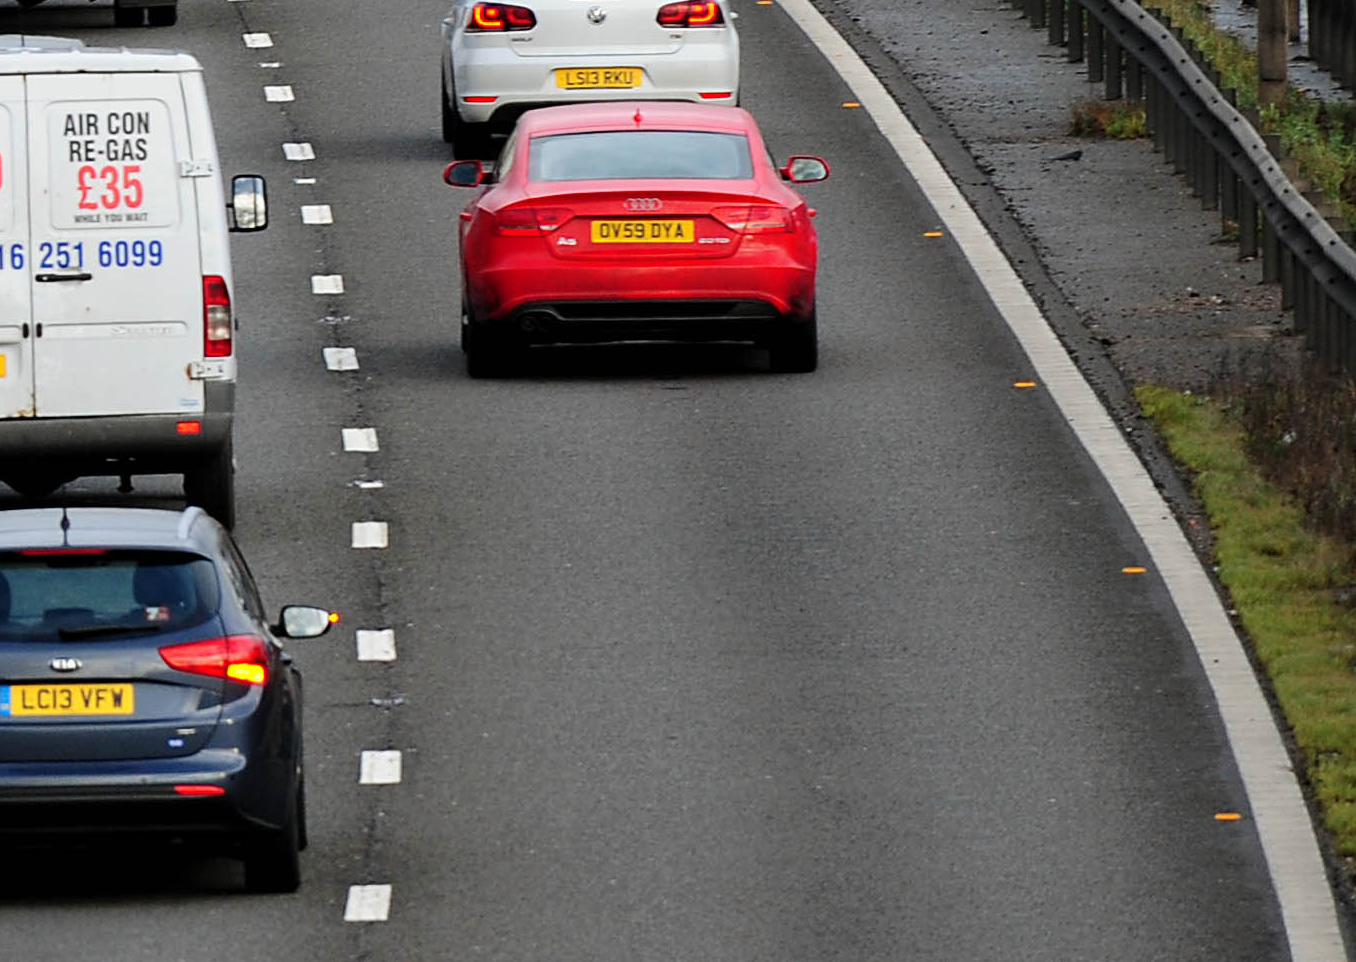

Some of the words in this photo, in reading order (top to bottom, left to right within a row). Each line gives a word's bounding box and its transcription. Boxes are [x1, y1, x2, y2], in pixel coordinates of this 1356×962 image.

[566, 71, 599, 86] LS13
[603, 70, 633, 85] RKU
[64, 113, 99, 137] AIR
[107, 111, 150, 135] CON
[69, 138, 148, 163] RE-GAS
[77, 164, 143, 210] £35
[74, 213, 101, 223] WHILE
[105, 213, 123, 222] YOU
[126, 212, 148, 222] WAIT
[599, 222, 645, 239] OV59
[651, 222, 684, 239] DYA
[39, 241, 84, 269] 251
[98, 239, 163, 267] 6099
[21, 688, 72, 710] LC13
[80, 688, 124, 709] VFW
